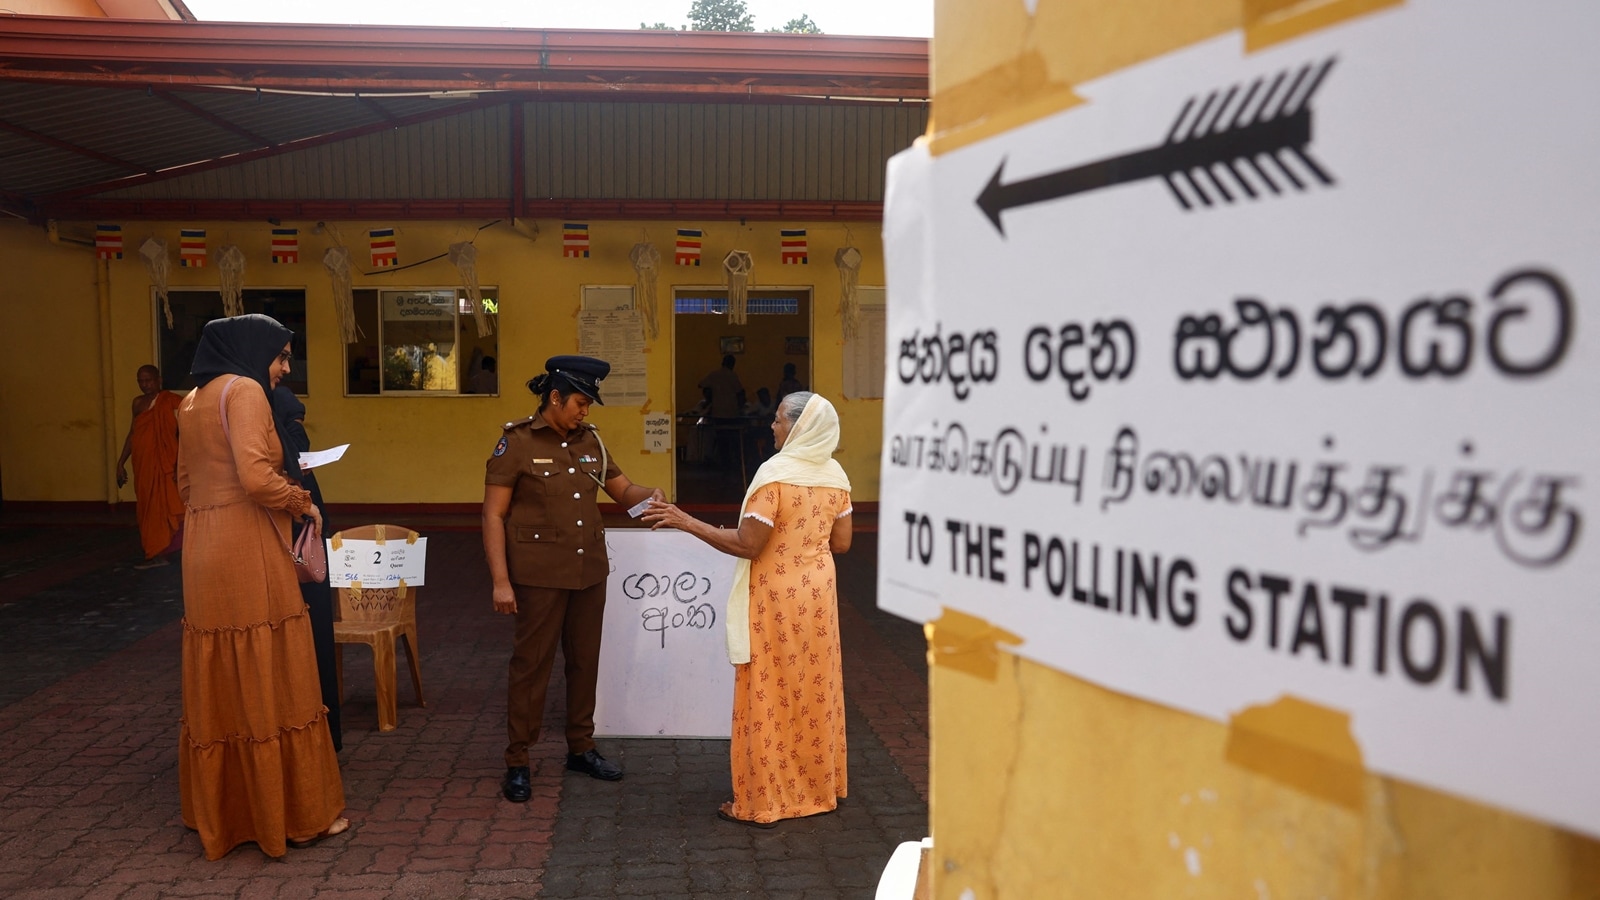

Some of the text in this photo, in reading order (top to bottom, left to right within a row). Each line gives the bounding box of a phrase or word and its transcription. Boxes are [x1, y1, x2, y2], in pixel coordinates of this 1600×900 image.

[1023, 318, 1137, 402] දෙන
[891, 421, 1583, 568] வாக்கெடுப்பு நிலையத்துக்கு
[373, 550, 382, 565] 2
[904, 510, 1511, 704] TO THE POLLING STATION
